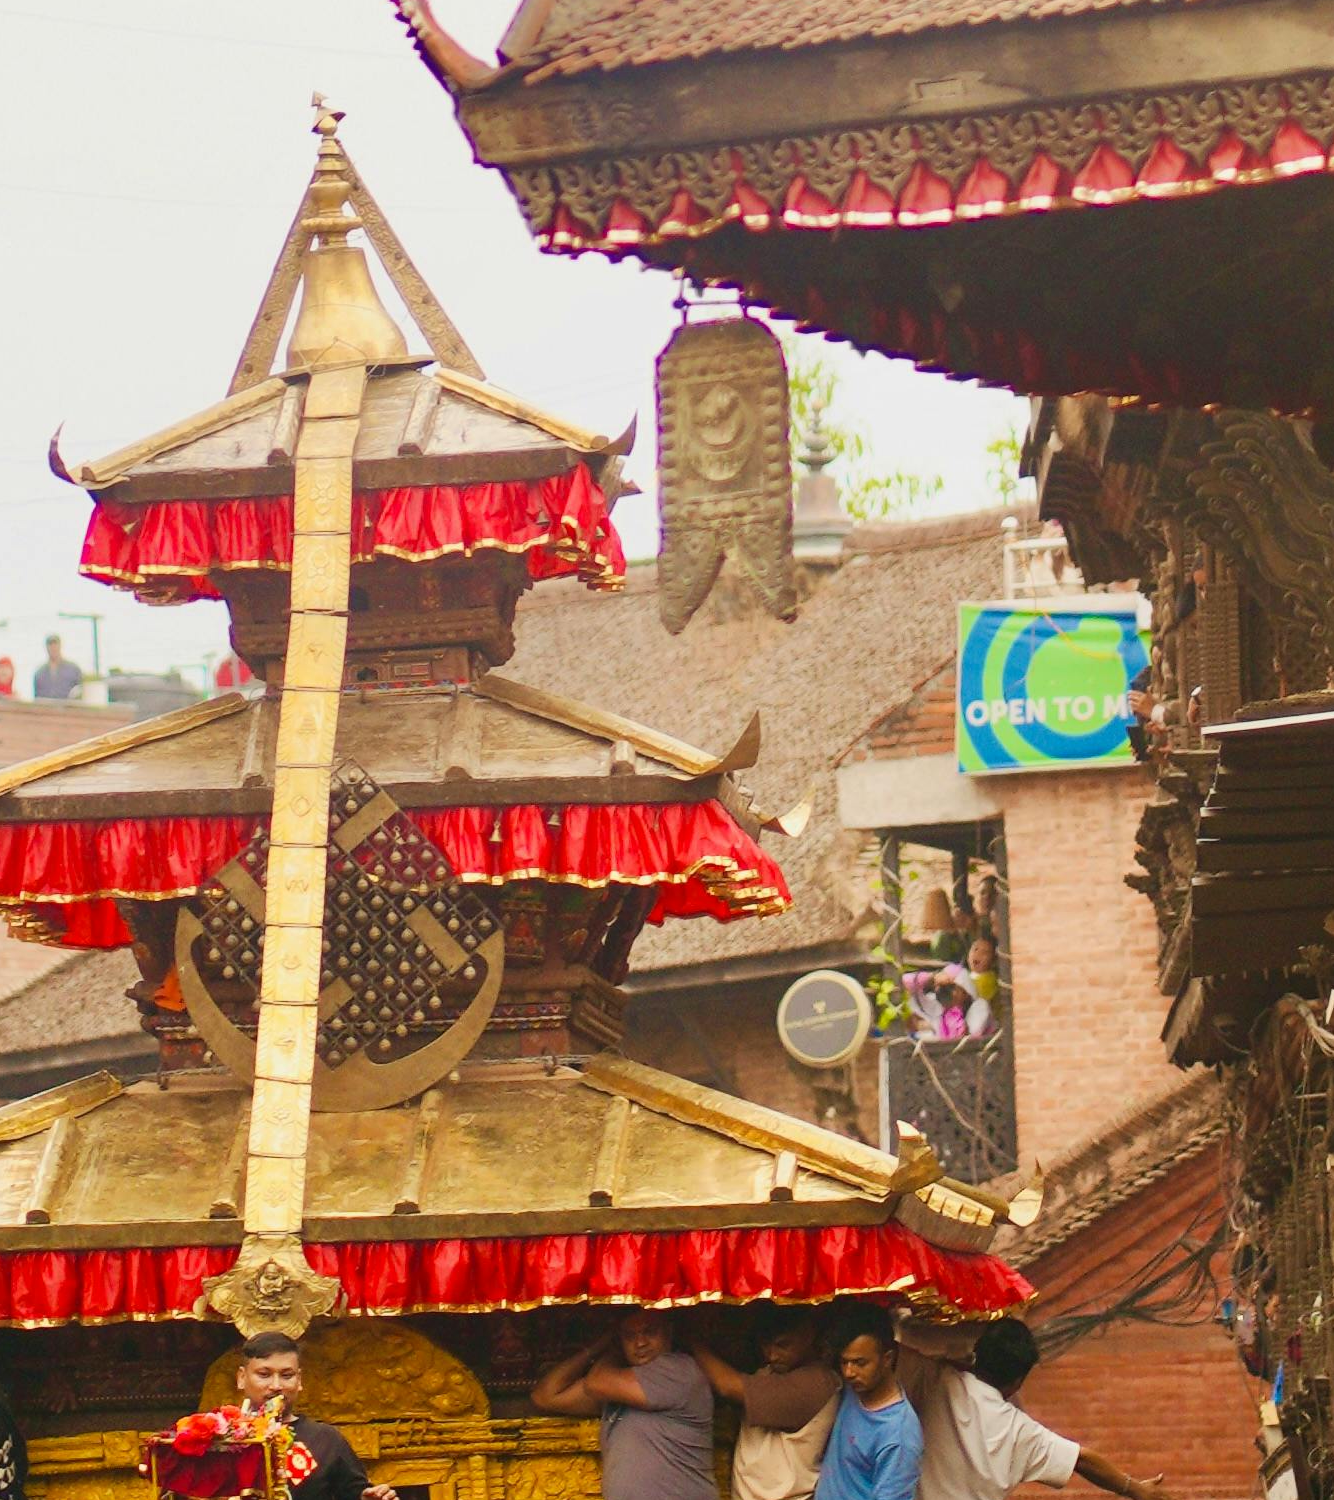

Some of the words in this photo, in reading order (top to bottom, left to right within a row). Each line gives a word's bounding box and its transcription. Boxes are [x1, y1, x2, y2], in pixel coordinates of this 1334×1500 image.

[966, 697, 1046, 727] OPEN
[1052, 695, 1095, 721] TO
[1100, 694, 1133, 720] M
